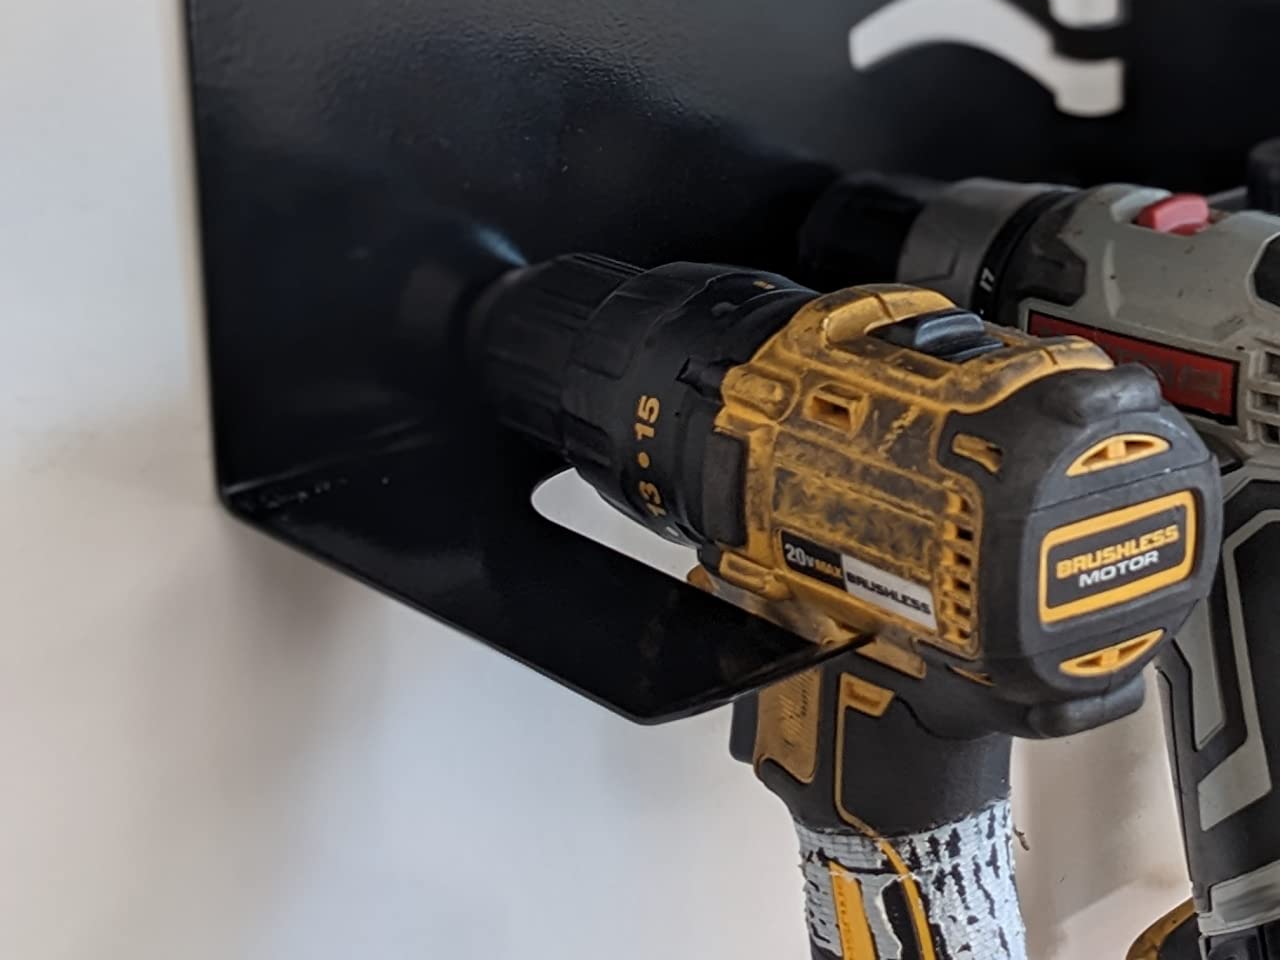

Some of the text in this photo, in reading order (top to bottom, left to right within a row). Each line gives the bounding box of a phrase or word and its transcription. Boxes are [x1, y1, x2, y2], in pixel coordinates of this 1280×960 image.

[634, 395, 661, 440] 15
[1055, 524, 1180, 579] BRUSHLESS
[1078, 550, 1160, 588] MOTOR
[846, 571, 932, 616] BRUSHLESS
